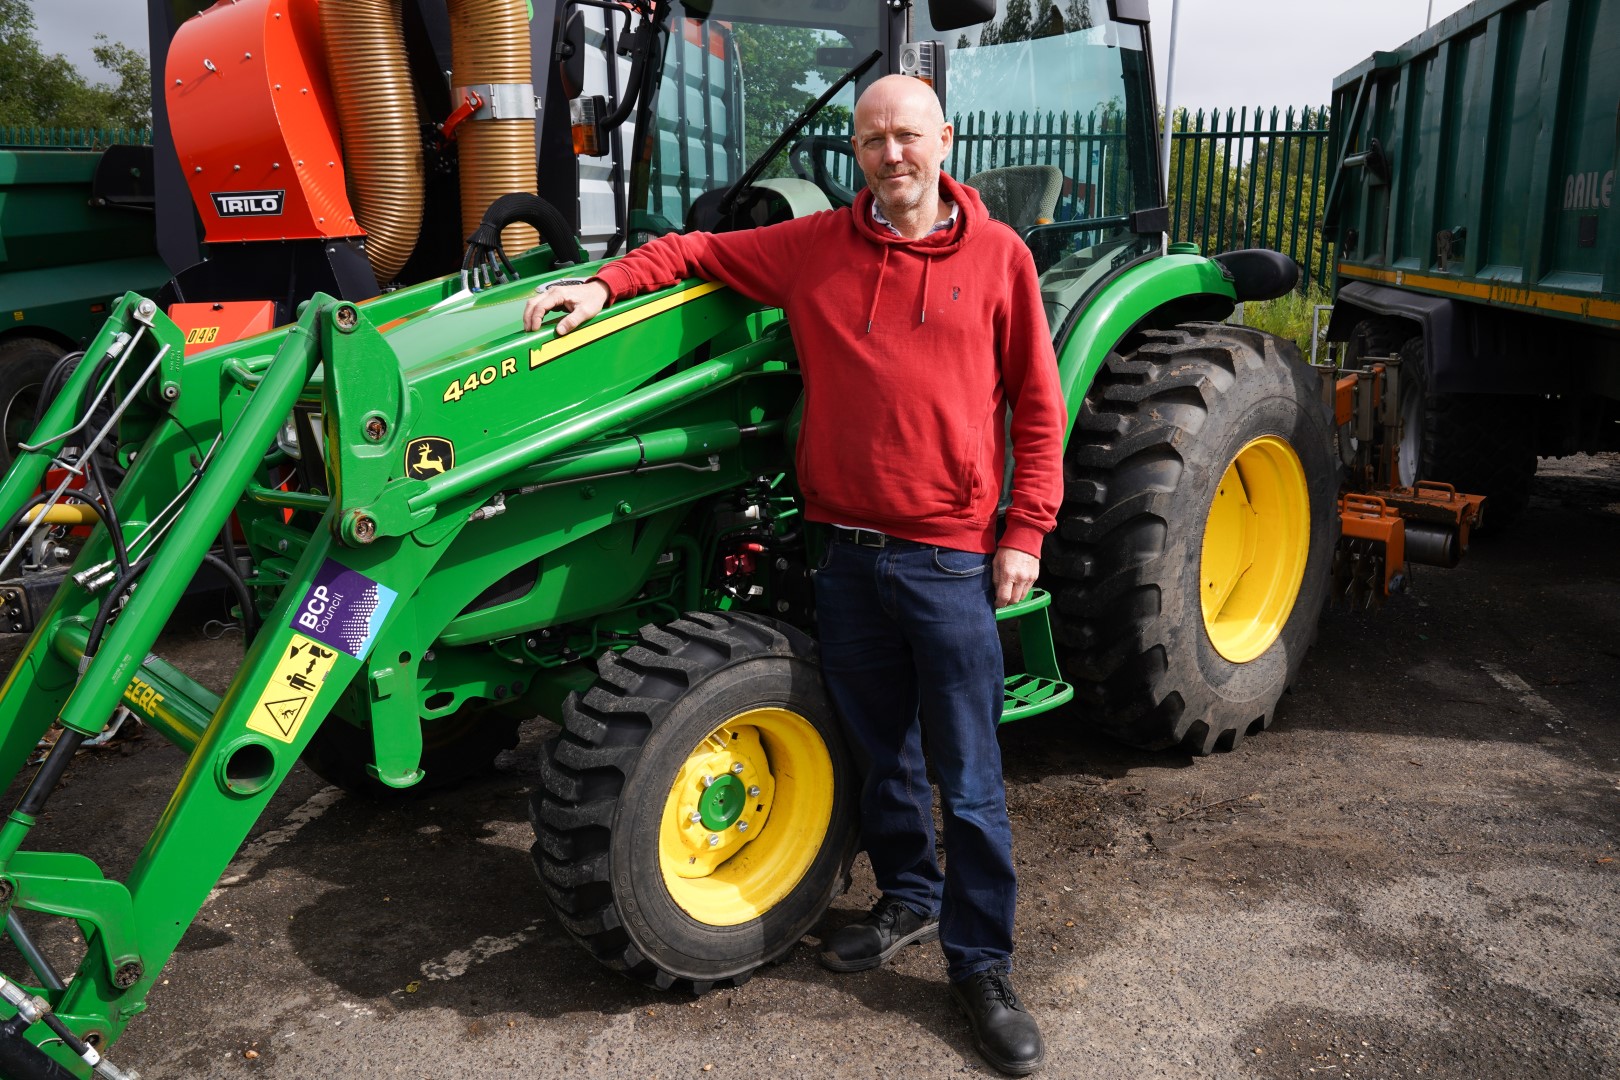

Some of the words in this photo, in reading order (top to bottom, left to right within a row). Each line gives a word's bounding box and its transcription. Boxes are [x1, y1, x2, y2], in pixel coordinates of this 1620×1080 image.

[217, 194, 279, 213] TRILO
[187, 328, 217, 343] 043
[443, 365, 498, 404] 440
[501, 356, 518, 378] R
[298, 585, 330, 630] BCP
[315, 592, 344, 633] Council
